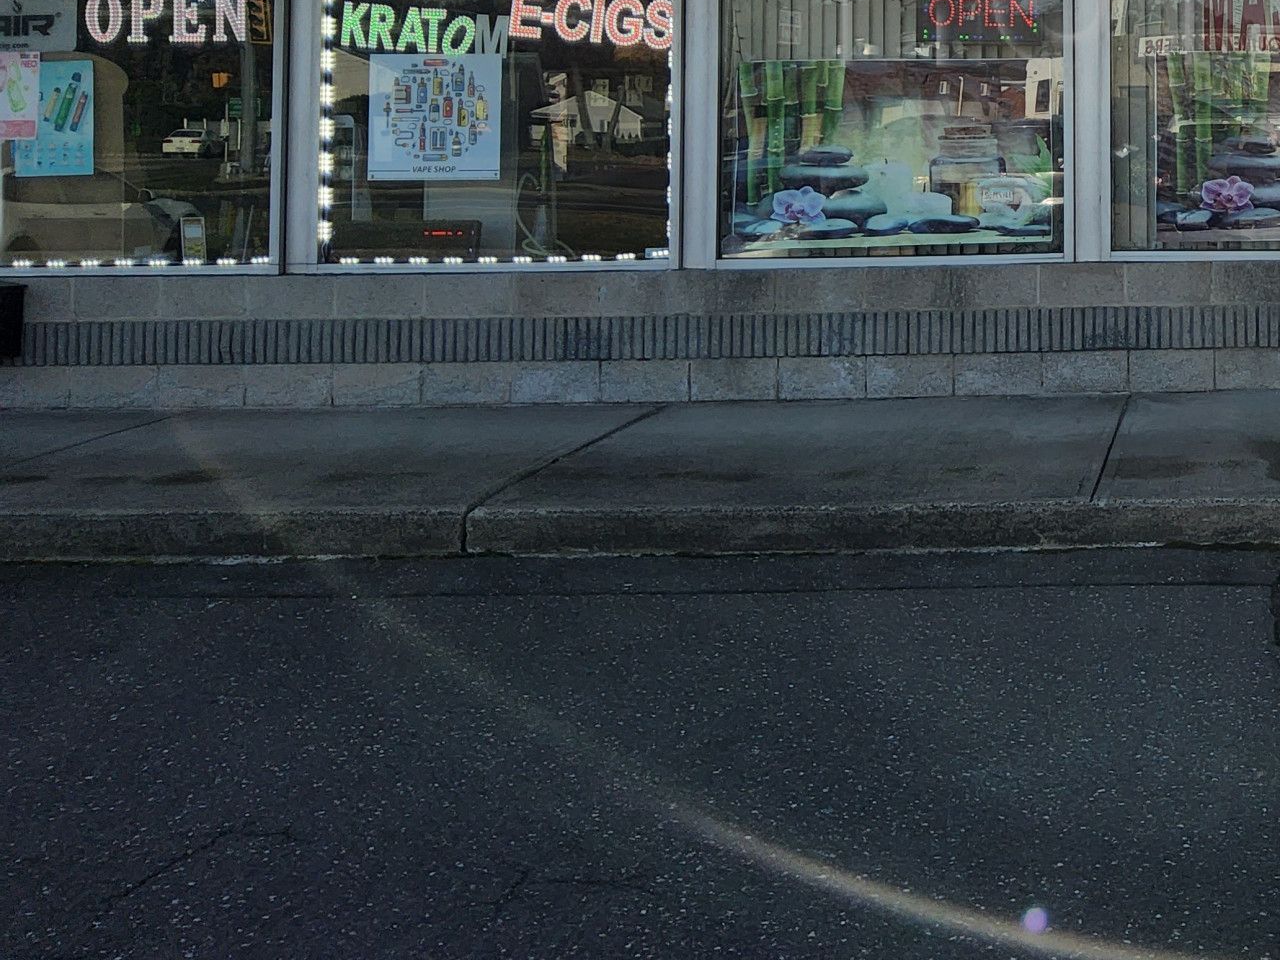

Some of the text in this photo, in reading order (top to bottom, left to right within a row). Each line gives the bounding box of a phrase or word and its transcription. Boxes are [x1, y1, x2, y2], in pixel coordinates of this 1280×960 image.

[340, 0, 509, 58] KRATOM
[411, 166, 457, 174] VAPE SHOP
